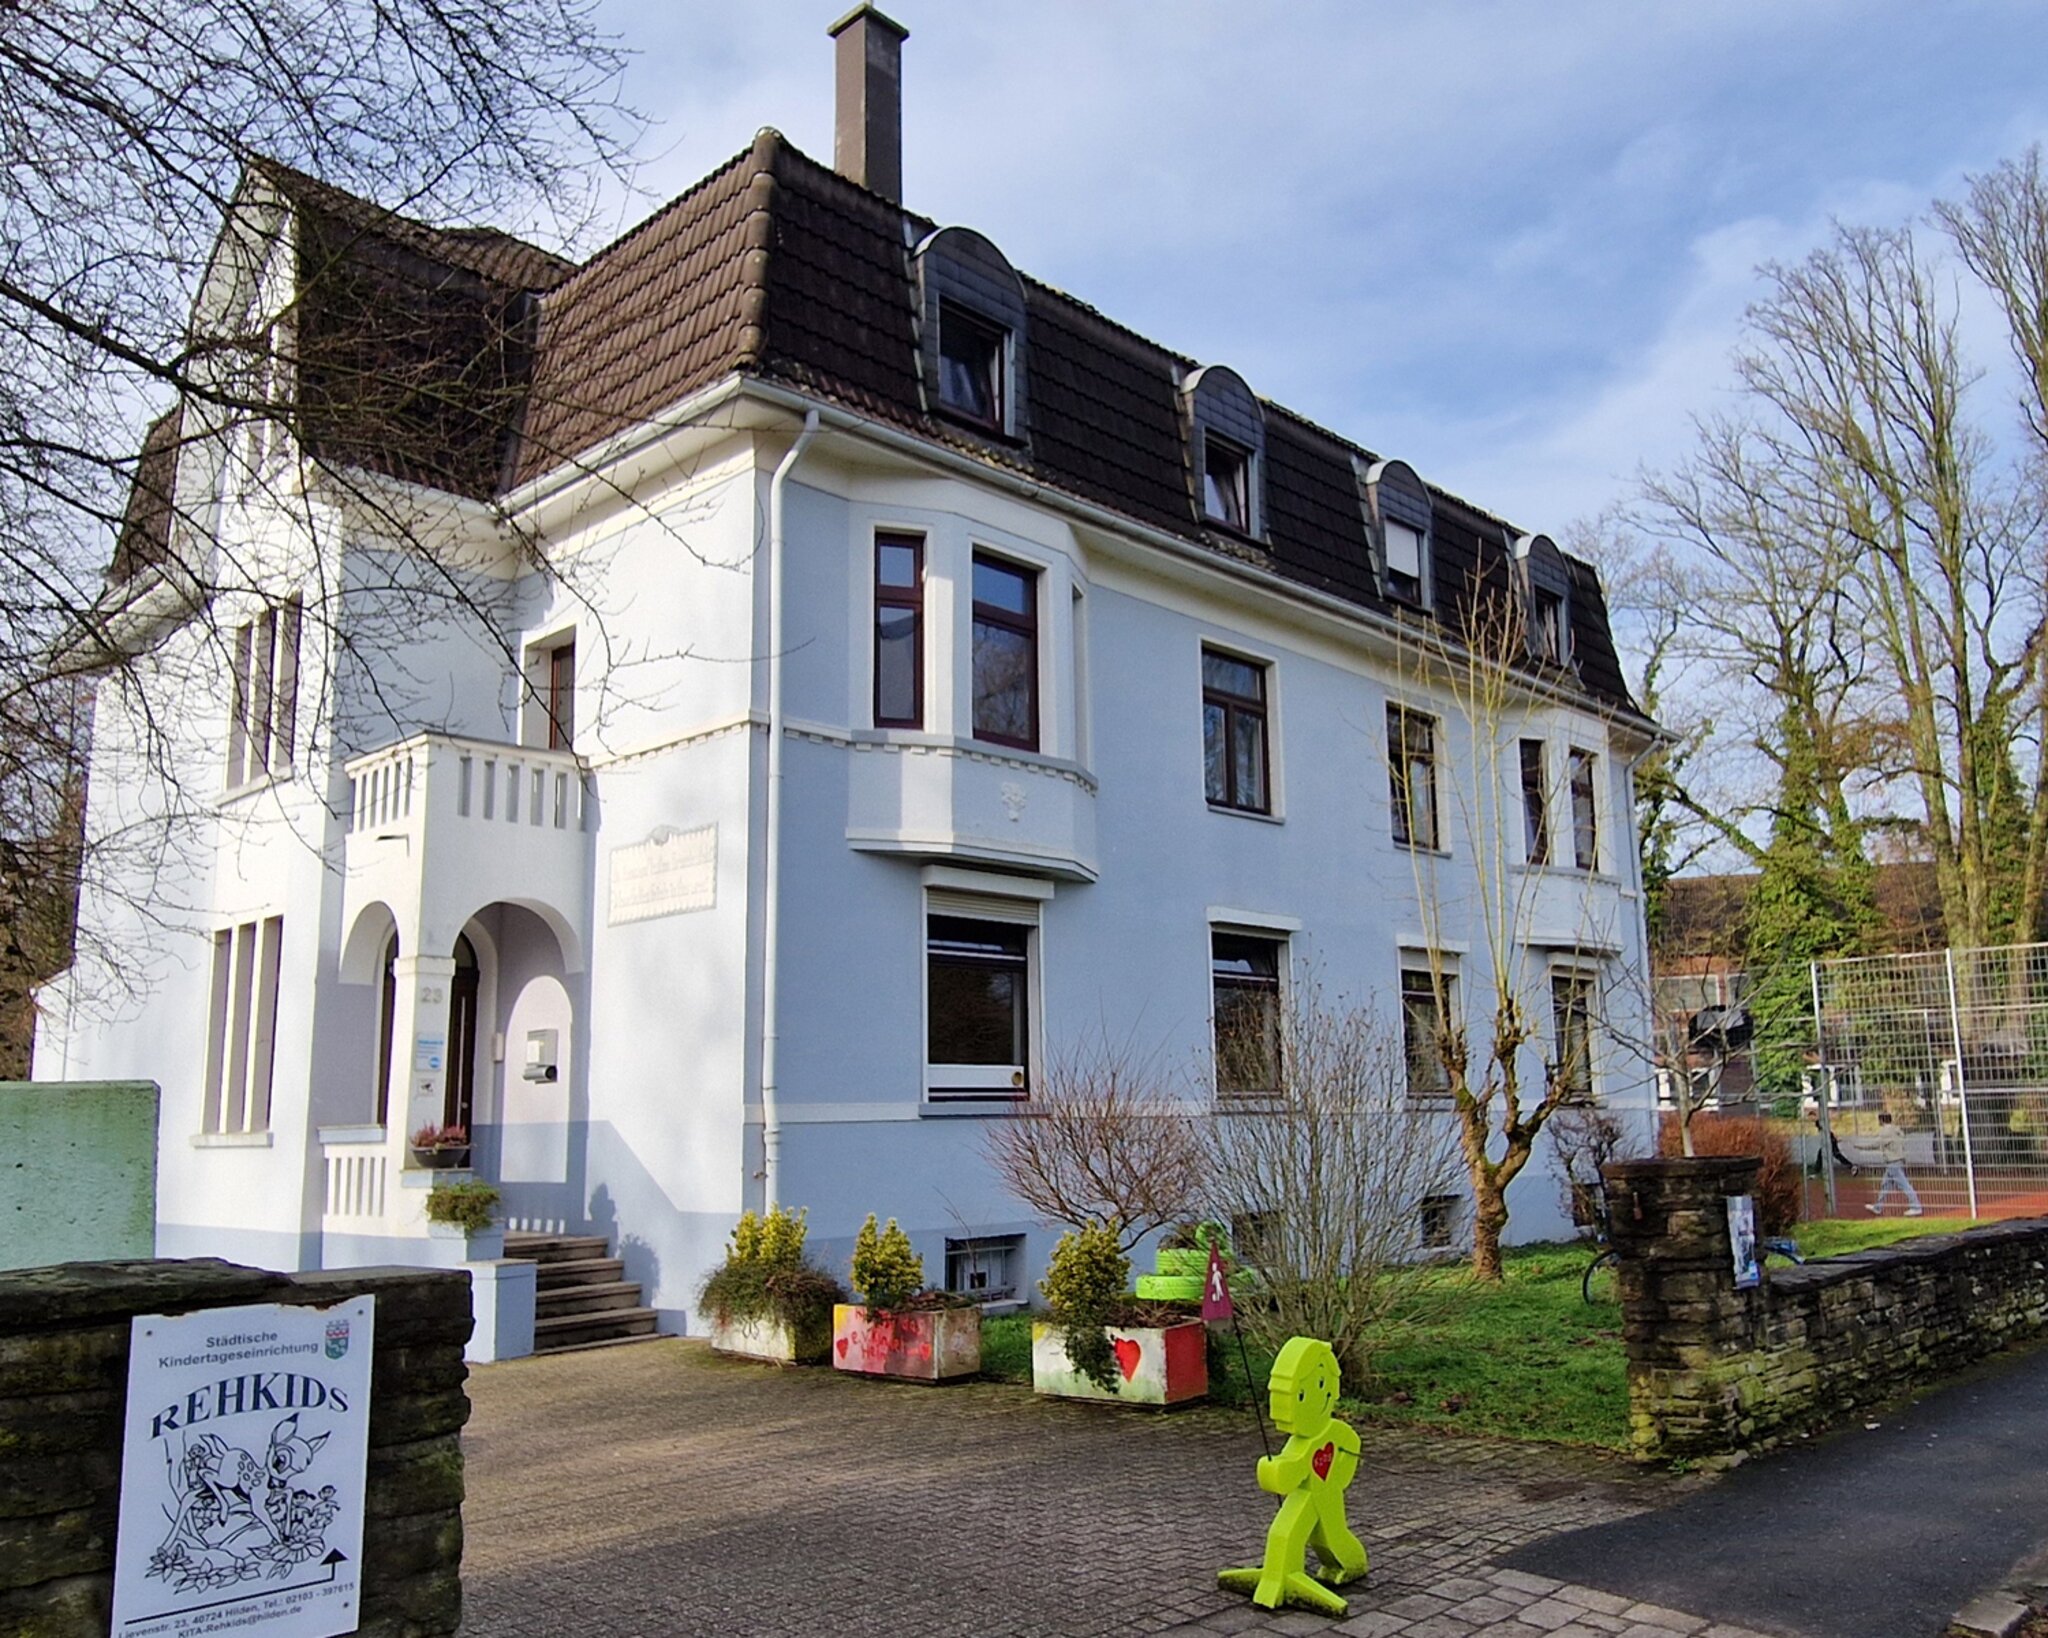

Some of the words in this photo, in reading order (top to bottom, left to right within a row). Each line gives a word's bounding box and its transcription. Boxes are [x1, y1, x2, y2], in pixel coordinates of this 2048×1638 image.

[421, 986, 443, 1004] 23
[206, 1331, 278, 1348] Städtische
[158, 1342, 319, 1368] Kindertageseinrichtung
[150, 1372, 349, 1441] REHKIDS
[192, 1611, 222, 1624] 40724
[285, 1591, 314, 1604] 02103
